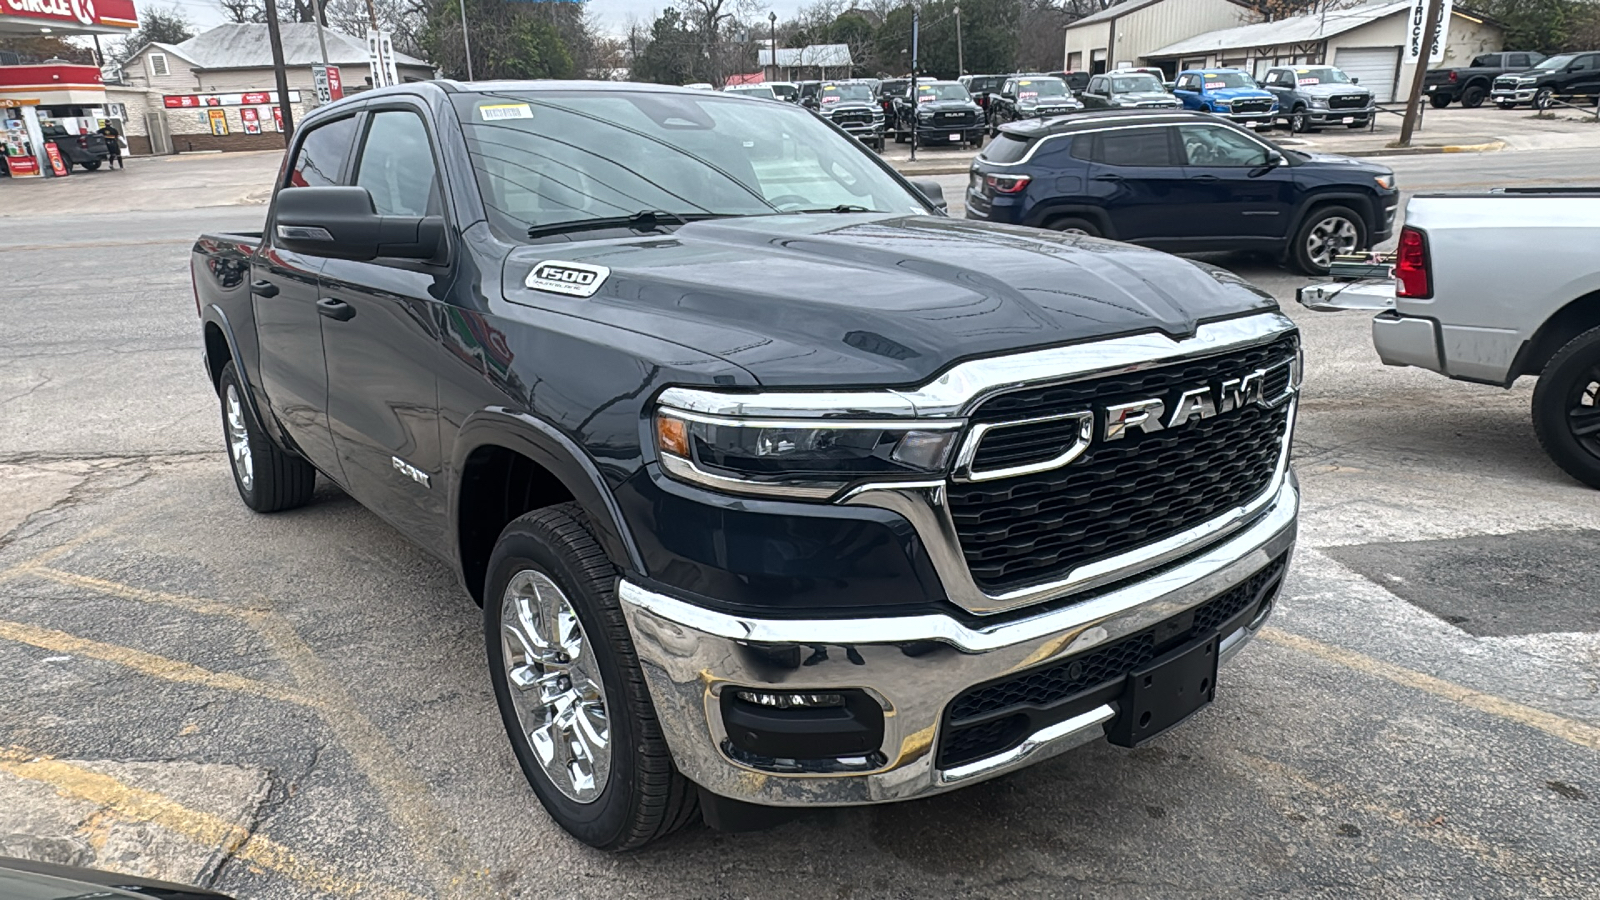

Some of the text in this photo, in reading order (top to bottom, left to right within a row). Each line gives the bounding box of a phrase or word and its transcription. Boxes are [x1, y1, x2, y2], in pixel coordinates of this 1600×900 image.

[7, 0, 72, 16] CIRCLE
[318, 87, 330, 101] 35
[541, 267, 596, 285] 1500
[1103, 369, 1266, 443] RAM
[391, 455, 431, 489] RAM
